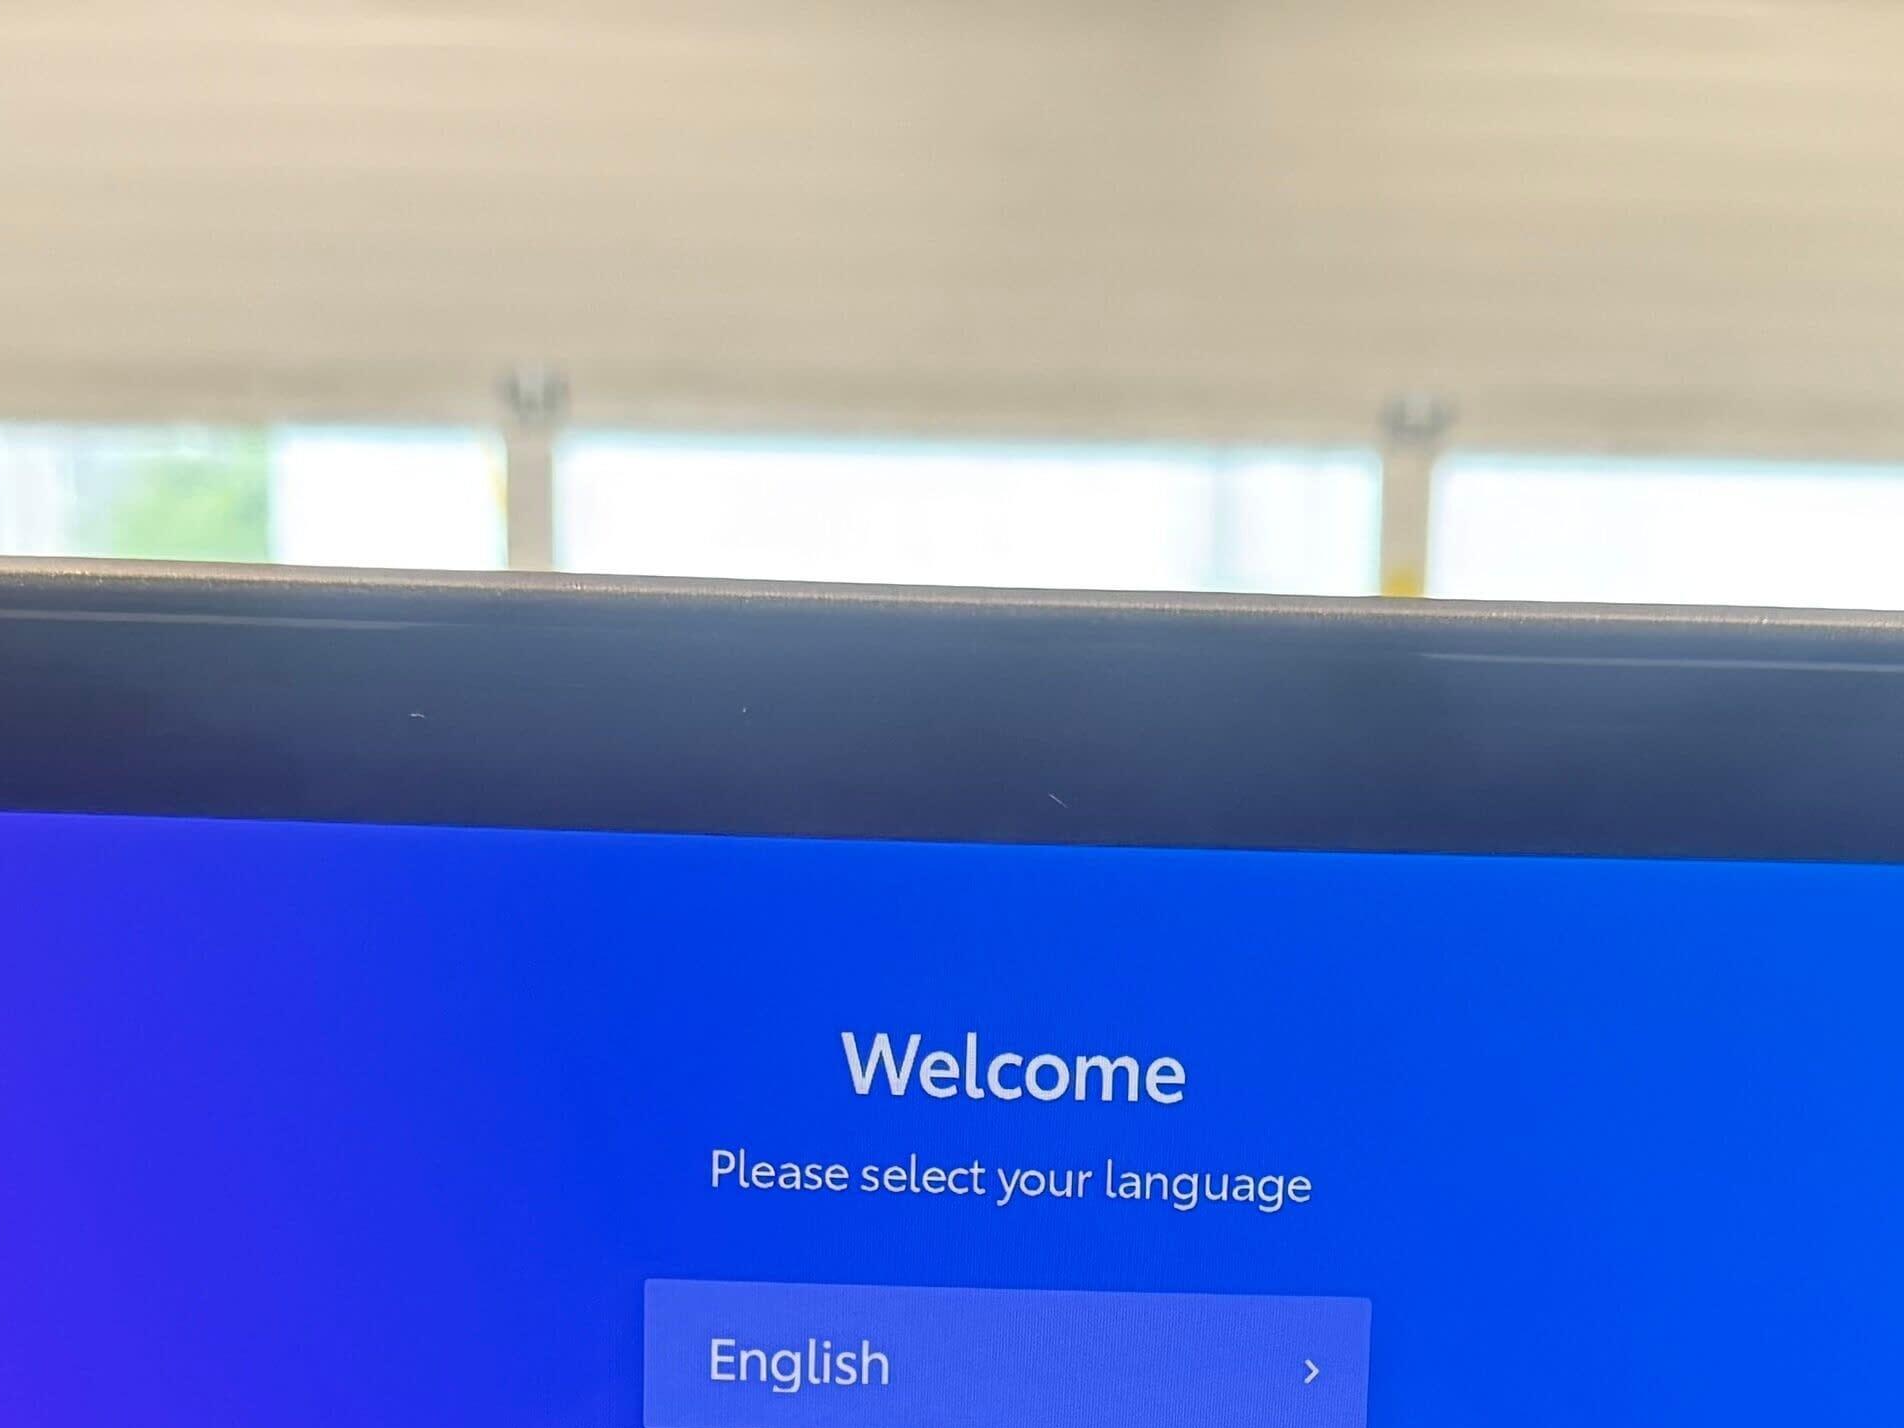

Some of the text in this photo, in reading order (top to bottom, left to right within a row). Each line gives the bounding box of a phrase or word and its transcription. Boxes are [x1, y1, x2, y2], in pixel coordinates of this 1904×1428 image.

[841, 1031, 1186, 1104] Welcome
[710, 1149, 1312, 1214] Please select your language
[708, 1339, 890, 1393] English
